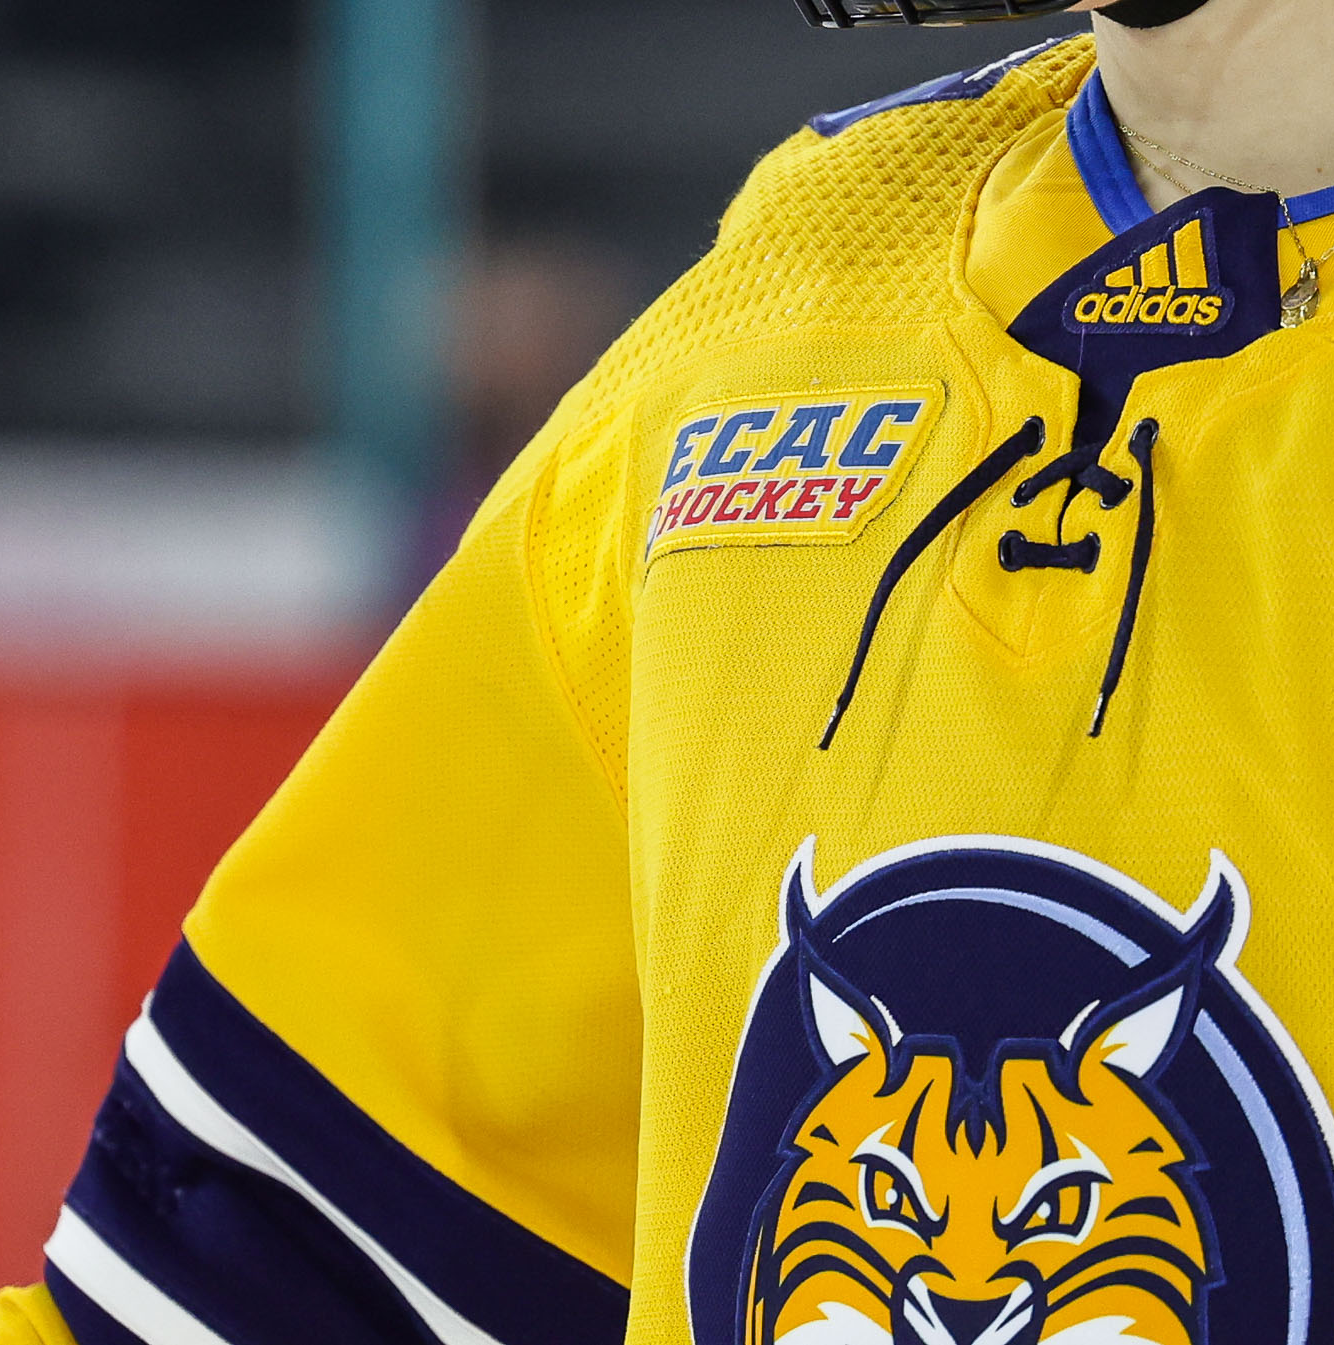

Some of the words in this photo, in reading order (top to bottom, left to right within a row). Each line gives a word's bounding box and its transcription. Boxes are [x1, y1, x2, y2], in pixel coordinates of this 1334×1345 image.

[1074, 285, 1222, 325] adidas
[661, 400, 924, 497] ECAC
[655, 476, 885, 538] HOCKEY
